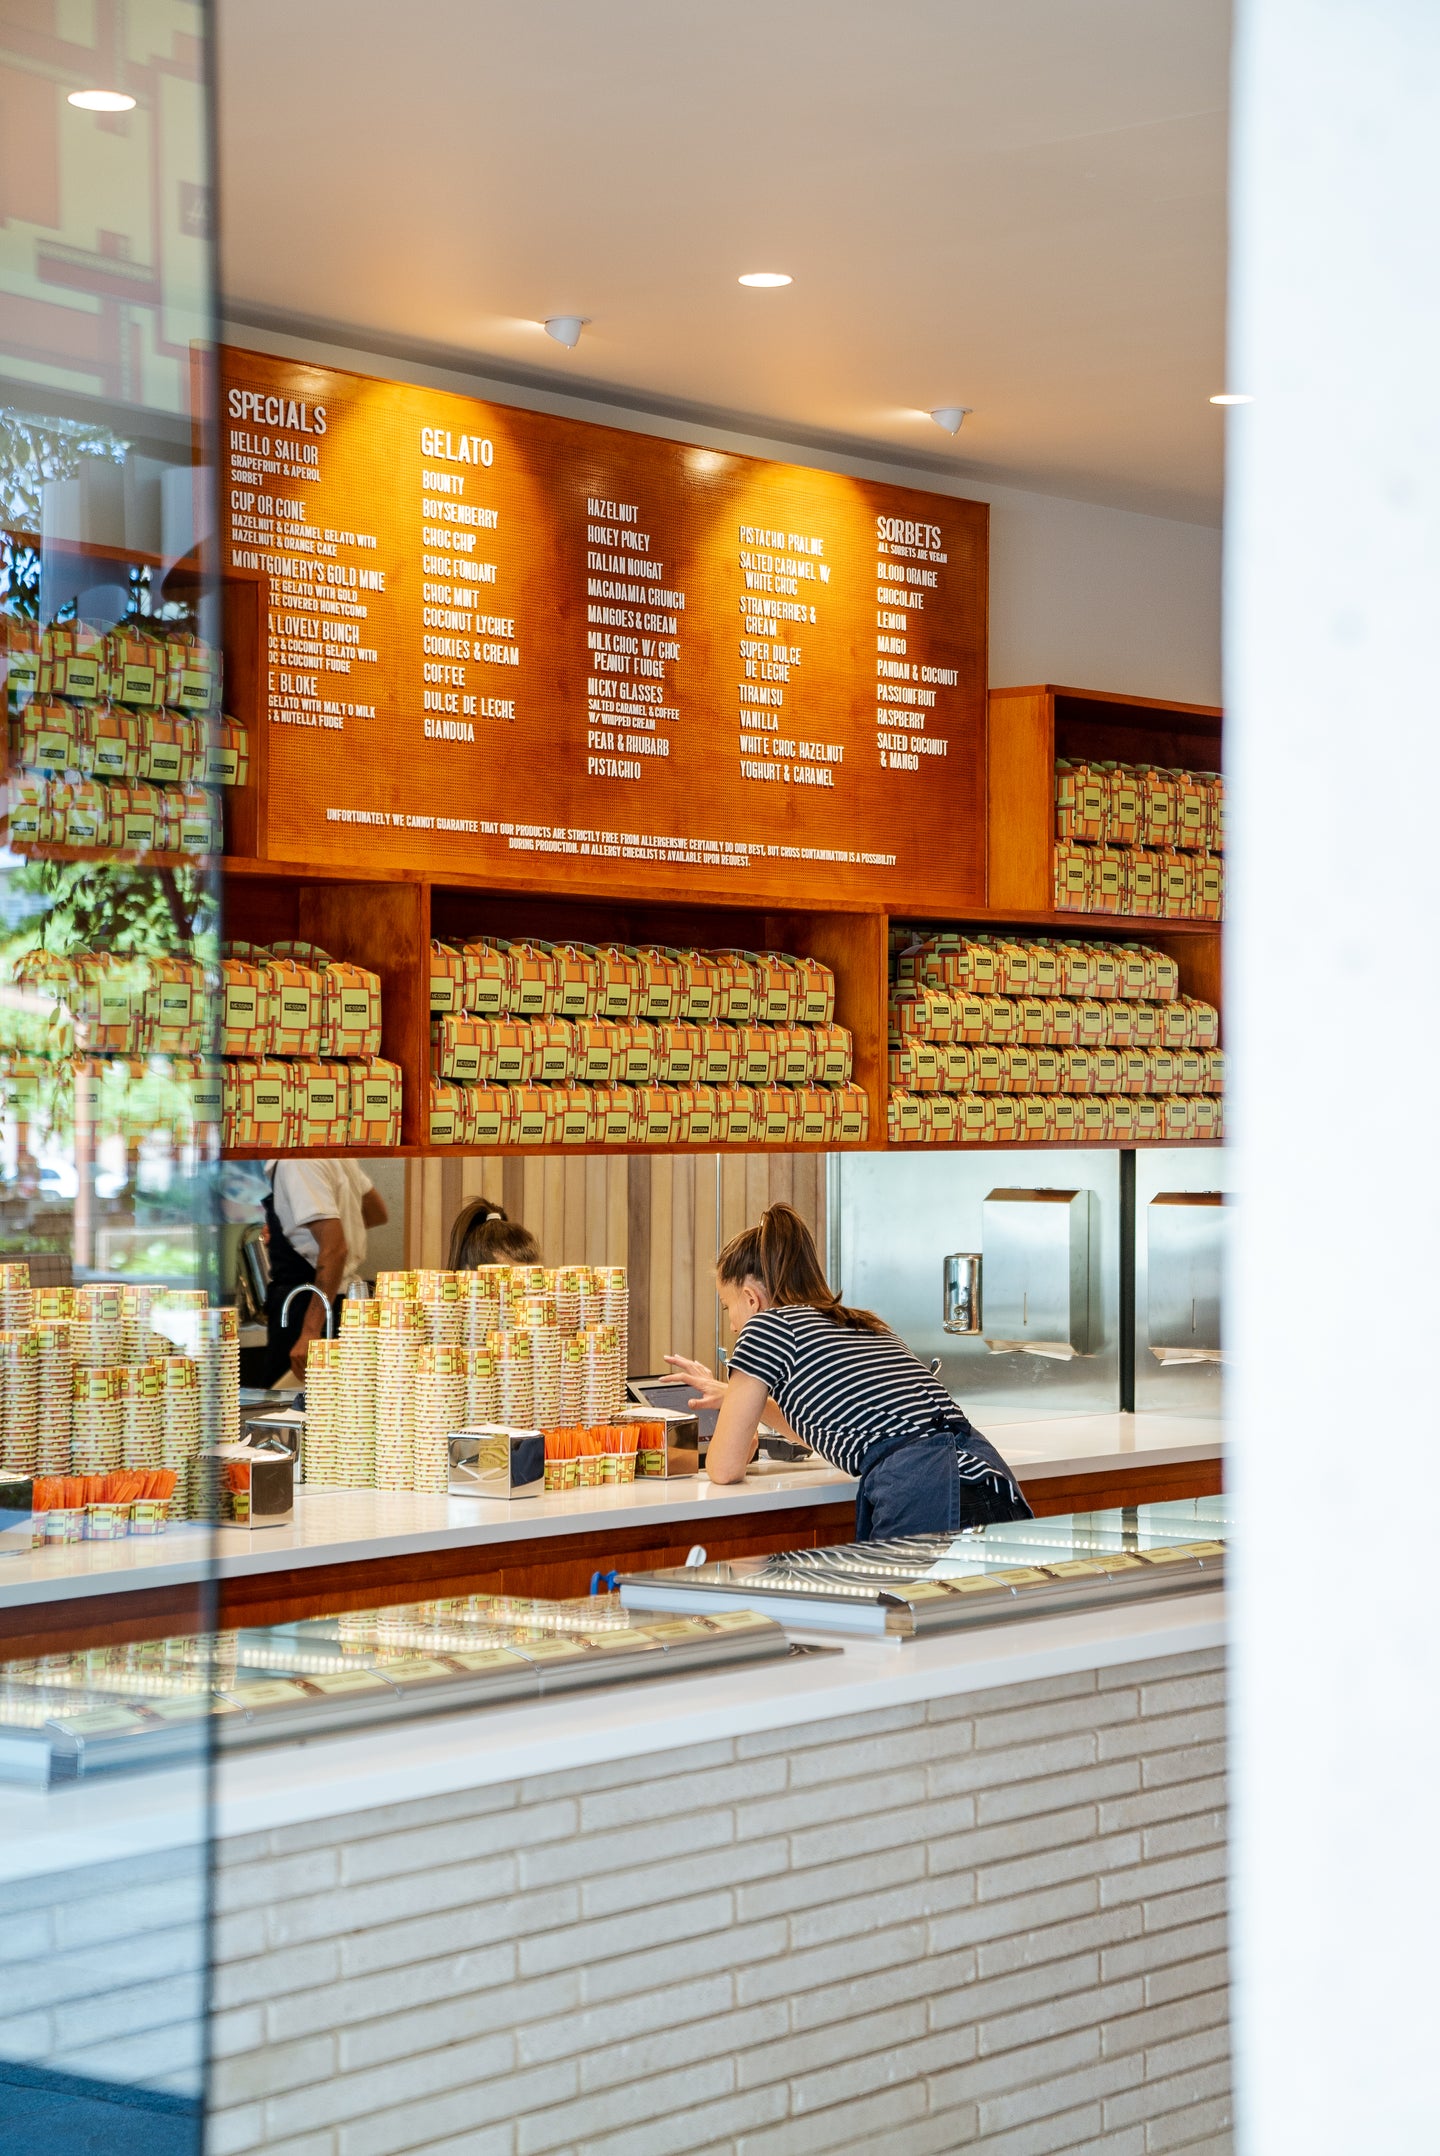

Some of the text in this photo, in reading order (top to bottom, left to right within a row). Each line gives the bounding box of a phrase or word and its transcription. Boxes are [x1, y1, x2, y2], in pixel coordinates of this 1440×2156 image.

[228, 389, 326, 434] SPECIALS
[230, 430, 318, 465] HELLO SAILOR
[421, 427, 492, 467] GELATO
[231, 455, 320, 482] GRAPEFRUIT & APEROL
[231, 470, 262, 485] SORBET
[422, 470, 463, 495] BOUNTY
[231, 490, 305, 520] CUP OR CONE
[422, 498, 497, 528] BOYSENBERRY
[588, 498, 638, 523] HAZELNUT
[232, 514, 376, 548] HAZELNUT & CARAMEL GELATO WITH
[232, 529, 337, 556] HAZELNUT & ORANGE CAKE
[423, 527, 476, 552] CHOC CHIP
[588, 525, 649, 552] HOKEY POKEY
[740, 526, 823, 556] PISTACHIO PRALINE
[877, 516, 940, 549] SORBETS
[877, 542, 947, 563] ALL SORBETS ARE VEGAN
[327, 564, 356, 587] GOLD
[359, 568, 385, 592] MINE
[423, 555, 496, 583] CHOC FONDANT
[588, 551, 662, 580] ITALIAN NOUGAT
[740, 552, 772, 573] SALTED
[775, 558, 816, 581] CARAMEL
[877, 562, 937, 587] BLOOD ORANGE
[282, 580, 312, 594] GELATO
[315, 585, 335, 598] WITH
[337, 588, 357, 602] GOLD
[423, 583, 478, 608] CHOC MINT
[588, 578, 684, 610] MACADAMIA CRUNCH
[745, 572, 797, 595] WHITE CHOC
[282, 595, 318, 611] COVERED
[320, 600, 367, 618] HONEYCOMB
[740, 596, 816, 623] STRAWBERRIES &
[877, 587, 923, 609] CHOCOLATE
[277, 615, 318, 638] LOVELY
[322, 621, 358, 644] BUNCH
[423, 608, 514, 637] COCONUT LYCHEE
[588, 605, 676, 634] MANGOES & CREAM
[746, 616, 776, 636] CREAM
[877, 611, 906, 630] LEMON
[280, 638, 286, 650] &
[288, 639, 322, 655] COCONUT
[325, 644, 355, 659] GELATO
[357, 648, 377, 662] WITH
[423, 635, 518, 665] COOKIES & CREAM
[588, 631, 610, 651] MILK
[613, 635, 638, 655] CHOC
[658, 641, 680, 660] CHOC
[740, 640, 800, 665] SUPER DULCE
[877, 636, 906, 655] MANGO
[280, 653, 286, 665] &
[288, 654, 323, 669] COCONUT
[325, 658, 350, 672] FUDGE
[424, 663, 465, 686] COFFEE
[594, 652, 664, 678] PEANUT FUDGE
[746, 660, 789, 682] DE LECHE
[877, 660, 958, 686] PANDAN & COCONUT
[280, 673, 317, 696] BLOKE
[588, 678, 662, 703] NICKY GLASSES
[739, 684, 782, 706] TIRAMISU
[877, 684, 936, 706] PASSIONFRUIT
[268, 695, 298, 710] GELATO
[301, 699, 321, 712] WITH
[355, 704, 375, 718] MILK
[424, 691, 514, 719] DULCE DE LECHE
[588, 699, 679, 720] SALTED CARAMEL & COFFEE
[273, 709, 279, 722] &
[281, 710, 316, 726] NUTELLA
[318, 714, 343, 729] FUDGE
[424, 719, 474, 742] GIANDUIA
[601, 713, 630, 727] WHIPPED
[632, 717, 655, 730] CREAM
[740, 710, 778, 730] VANILLA
[877, 708, 924, 729] RASPBERRY
[588, 731, 668, 756] PEAR & RHUBARB
[740, 735, 843, 762] WHITE CHOC HAZELNUT
[877, 732, 947, 756] SALTED COCONUT
[588, 757, 640, 779] PISTACHIO
[740, 760, 834, 786] YOGHURT & CARAMEL
[880, 751, 918, 771] & MANGO
[327, 808, 639, 845] UNFORTUNATELY WE CANNOT GUARANTEE THAT OUR PRODUCTS ARE STRICTLY FREE FROM
[509, 838, 657, 860] DURING ALLERGY CHECKLIST
